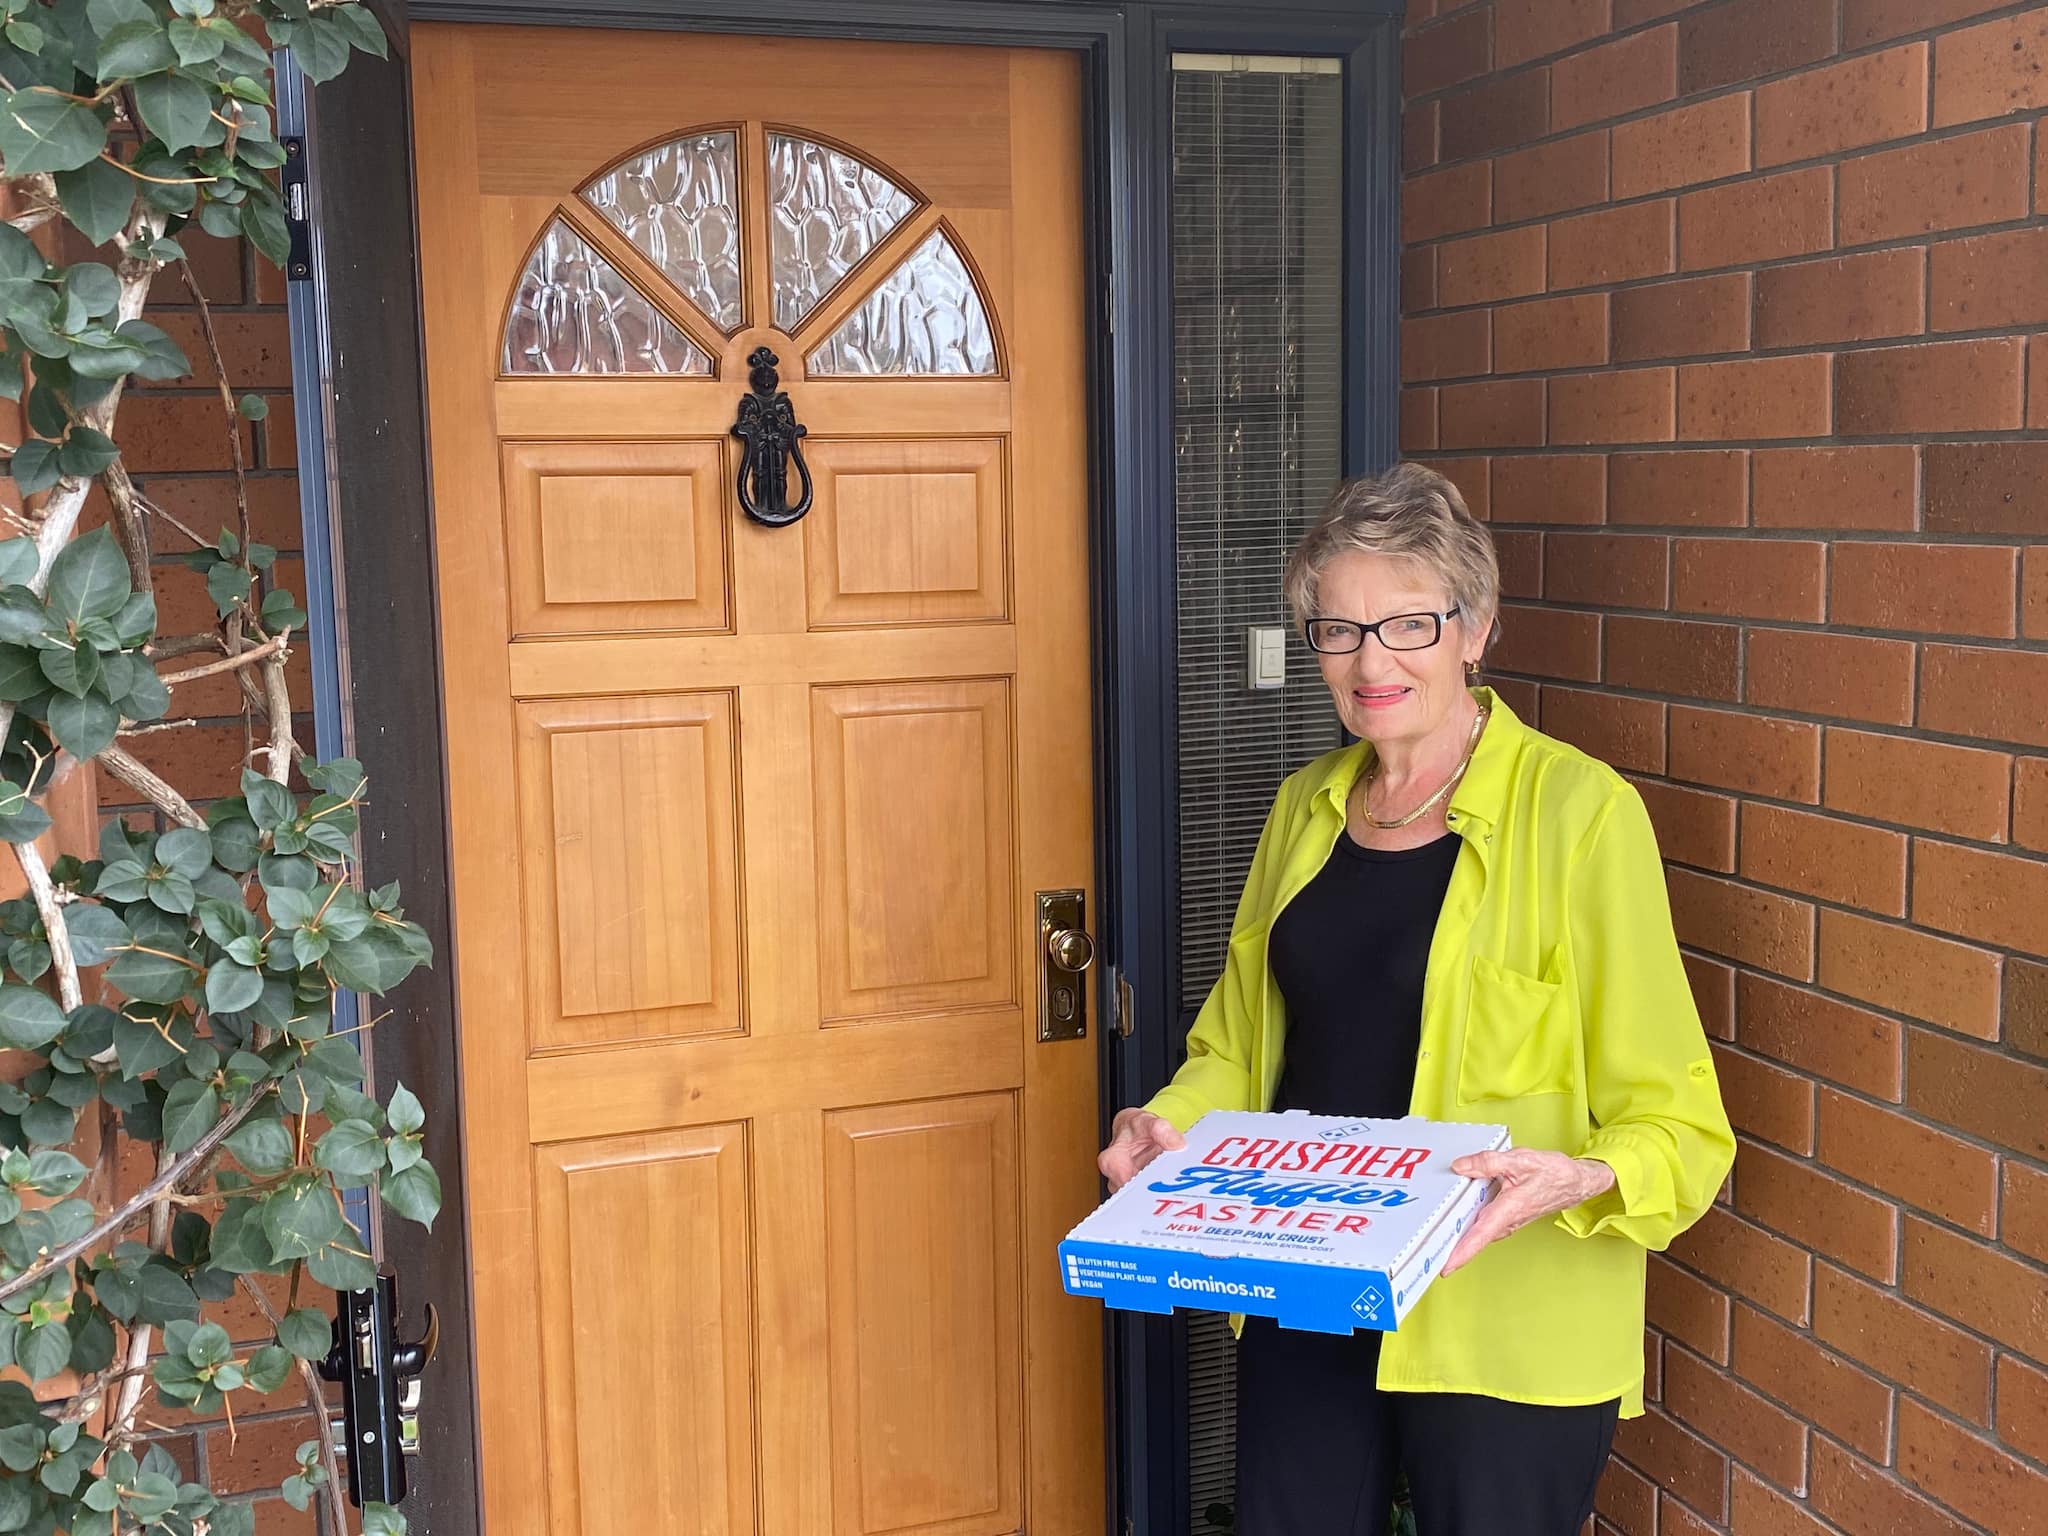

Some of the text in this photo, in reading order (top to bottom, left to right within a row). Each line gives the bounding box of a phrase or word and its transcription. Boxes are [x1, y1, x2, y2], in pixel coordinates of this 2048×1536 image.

[1200, 1136, 1432, 1179] CRISPIER
[1147, 1165, 1418, 1208] Fluffier
[1152, 1199, 1372, 1234] TASTIER
[1165, 1223, 1328, 1245] NEW DEEP PAN CRUST
[1077, 1257, 1138, 1270] GLUTEN FREE BASE
[1079, 1269, 1157, 1284] VEGETARIAN PLANT-BASED
[1081, 1280, 1103, 1288] VEGAN
[1168, 1271, 1276, 1299] dominos.nz
